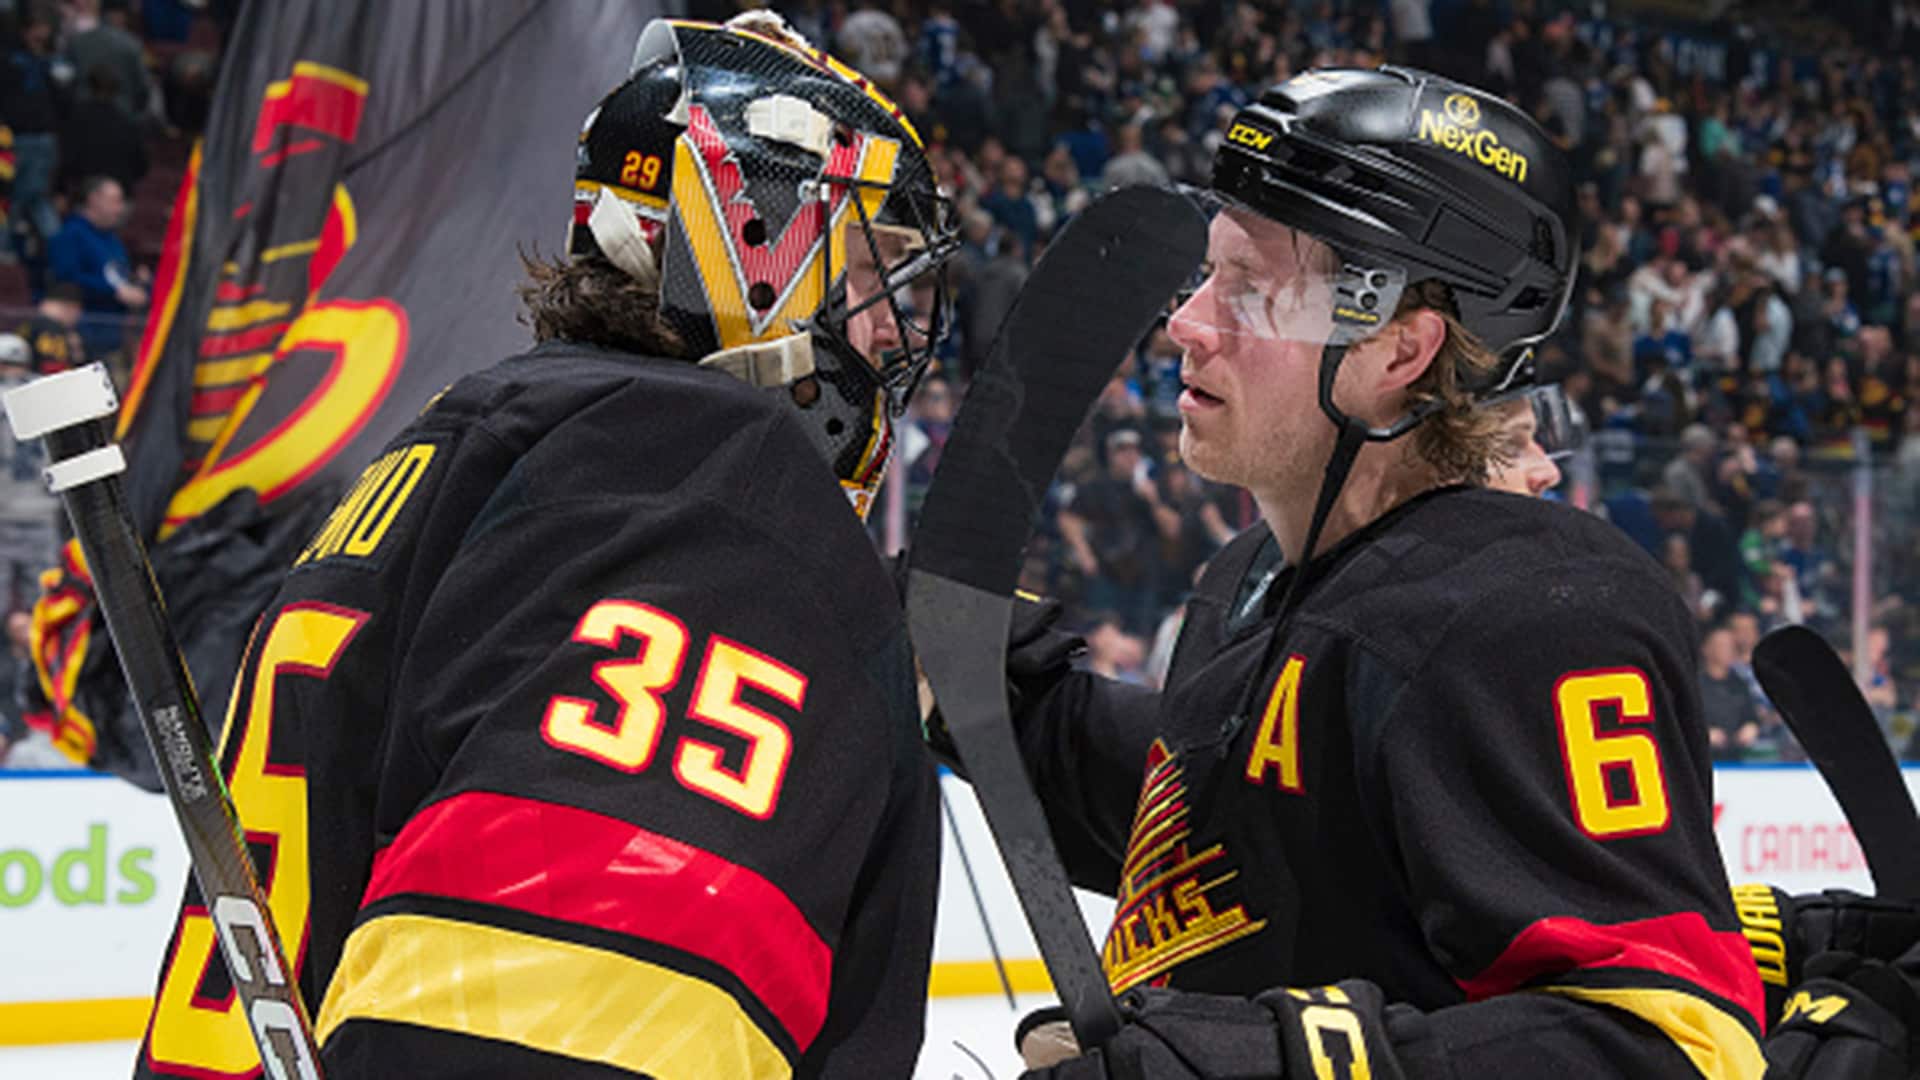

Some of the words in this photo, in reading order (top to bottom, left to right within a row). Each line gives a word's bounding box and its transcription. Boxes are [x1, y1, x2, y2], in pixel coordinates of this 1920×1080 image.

[620, 149, 663, 191] 29
[1228, 123, 1273, 150] CCM
[1419, 110, 1528, 183] NexGen
[540, 599, 809, 820] 35
[1246, 653, 1306, 795] A
[1552, 666, 1672, 841] 6
[0, 823, 157, 908] ods
[147, 600, 372, 1080] 5
[1740, 823, 1866, 873] CANAD
